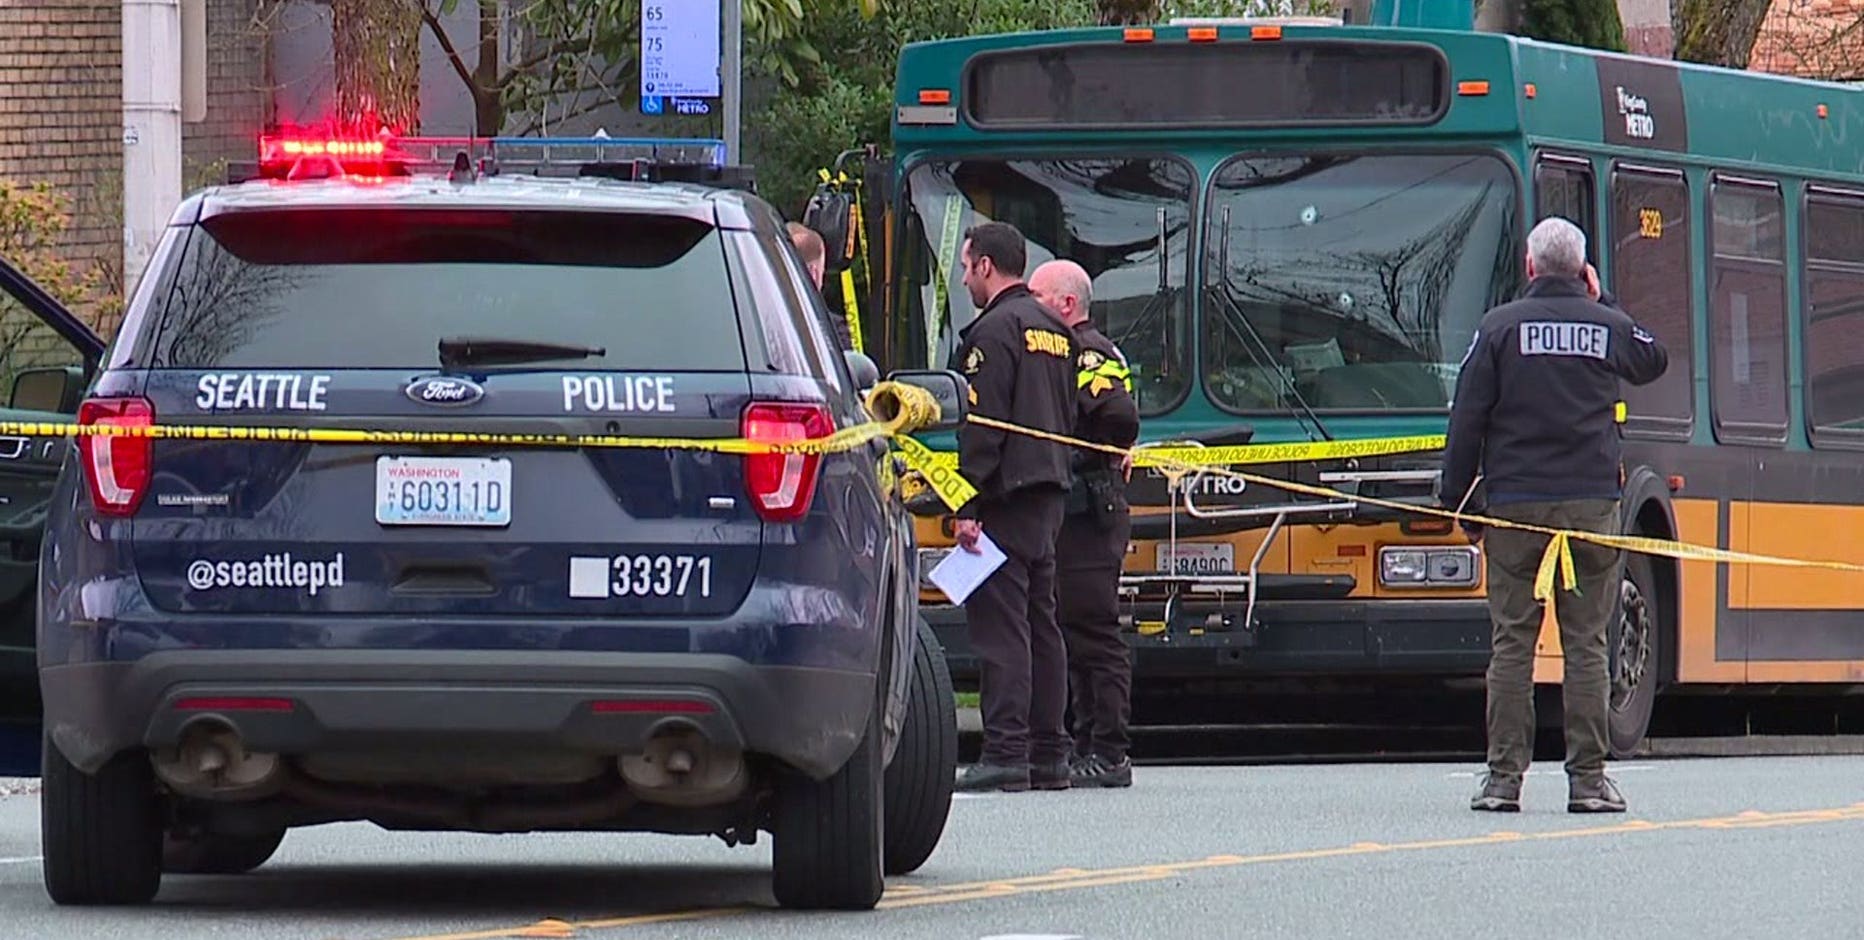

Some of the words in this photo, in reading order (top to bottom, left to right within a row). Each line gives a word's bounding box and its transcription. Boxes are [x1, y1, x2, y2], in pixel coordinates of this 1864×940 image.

[646, 6, 663, 21] 65
[646, 37, 663, 52] 75
[1626, 113, 1654, 139] METRO
[1639, 209, 1662, 238] 3629
[1527, 325, 1602, 355] POLICE
[196, 375, 330, 411] SEATTLE
[562, 376, 676, 412] POLICE
[423, 381, 466, 401] Ford
[388, 468, 460, 478] WASHINGTON
[401, 480, 502, 512] 60311D
[187, 552, 344, 595] @seattlepd
[612, 555, 711, 597] 33371
